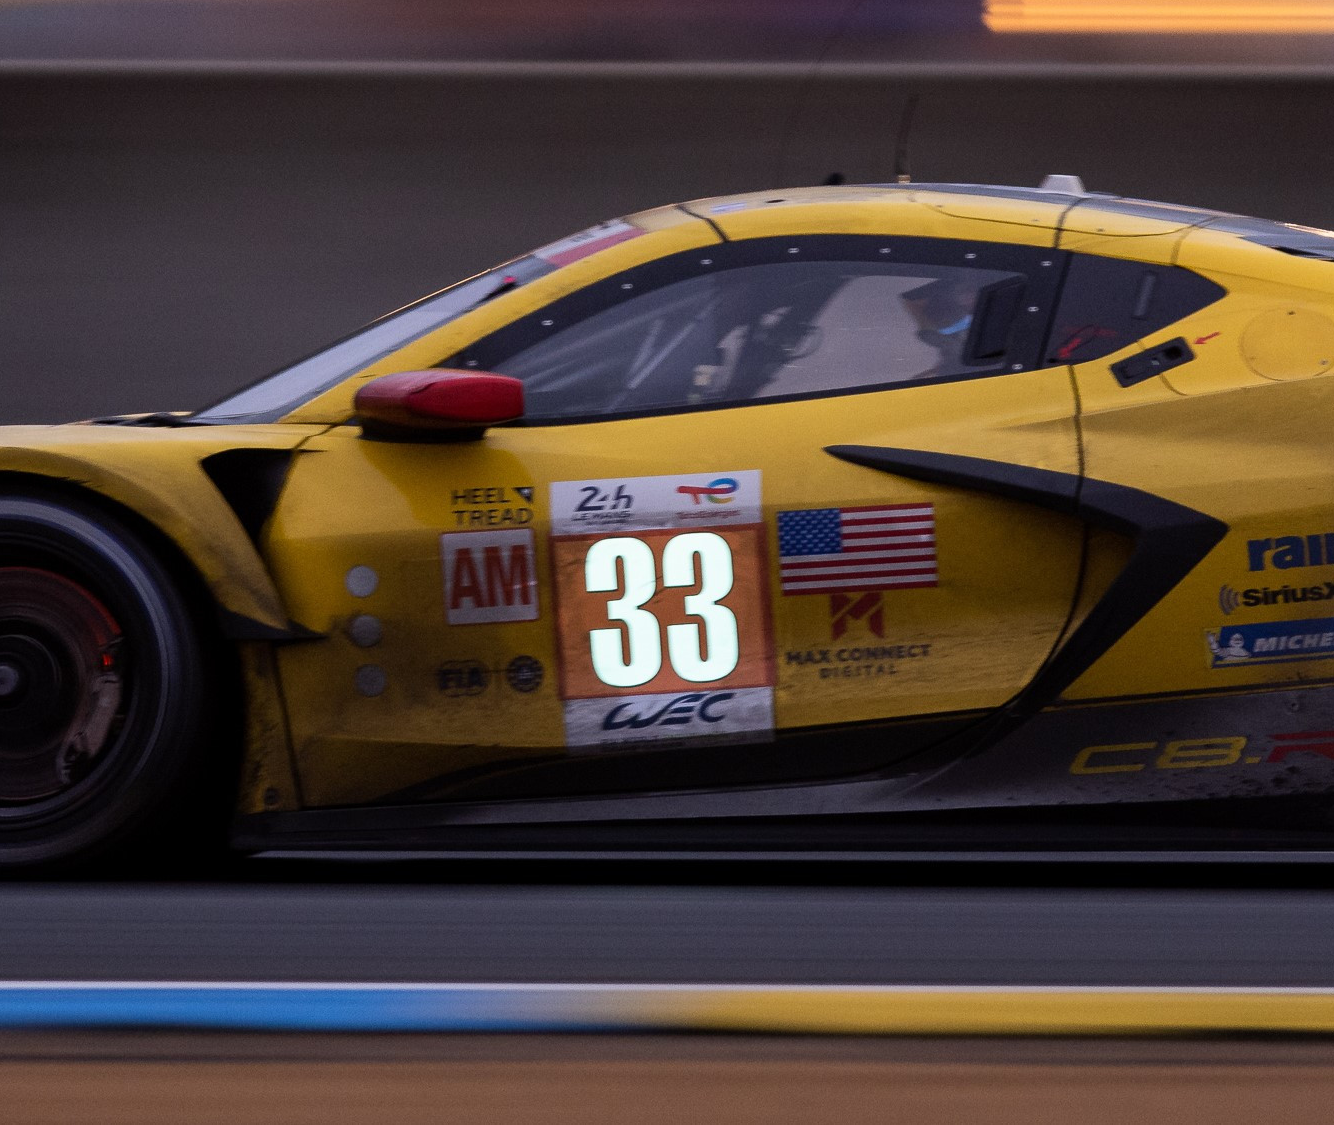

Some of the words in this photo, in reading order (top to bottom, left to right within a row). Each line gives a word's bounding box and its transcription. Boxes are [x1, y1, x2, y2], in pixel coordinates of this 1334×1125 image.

[451, 487, 511, 505] HEEL
[452, 507, 534, 526] TREAD
[450, 544, 533, 610] AM
[584, 531, 740, 688] 33
[786, 649, 830, 665] MAX
[835, 643, 932, 662] CONNECT
[602, 692, 735, 731] WEC
